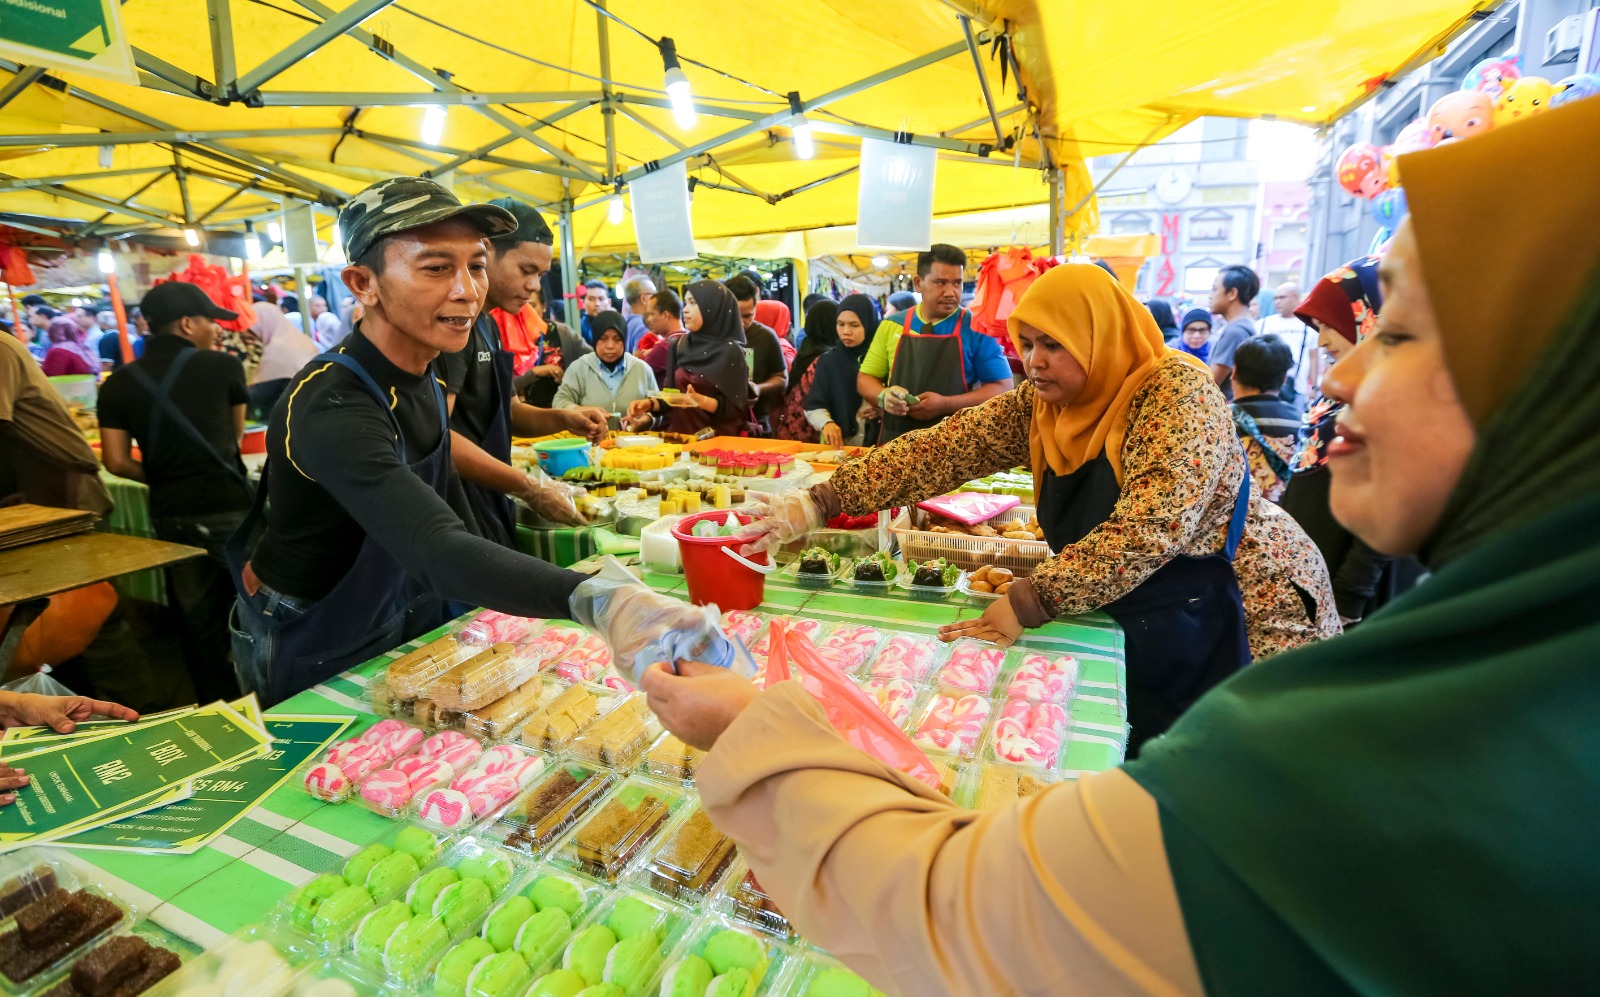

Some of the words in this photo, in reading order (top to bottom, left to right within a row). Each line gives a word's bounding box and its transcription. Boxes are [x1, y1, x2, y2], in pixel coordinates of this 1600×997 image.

[1156, 214, 1180, 296] MUAZ
[150, 744, 188, 767] BOX
[92, 759, 133, 786] RM2
[207, 780, 249, 793] RM4
